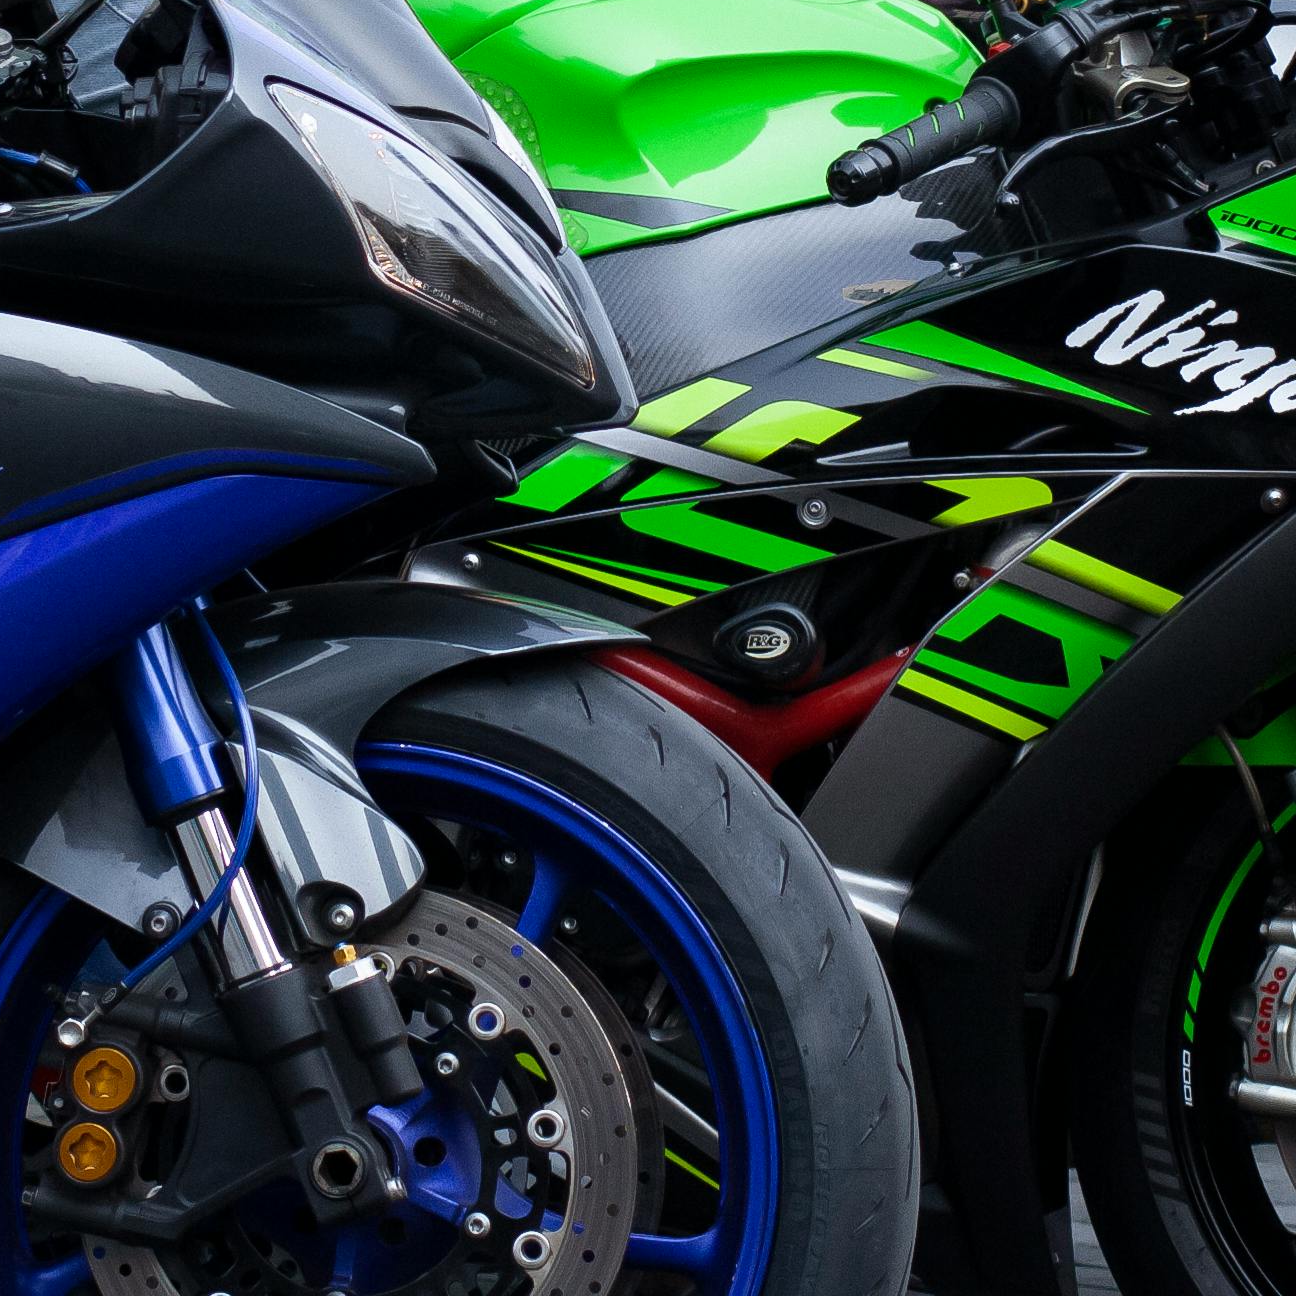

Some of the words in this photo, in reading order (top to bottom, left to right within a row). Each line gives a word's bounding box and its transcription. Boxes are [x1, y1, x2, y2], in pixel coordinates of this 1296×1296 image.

[747, 633, 783, 649] R&G
[1253, 966, 1288, 1064] brembo
[1182, 1049, 1194, 1107] 1000
